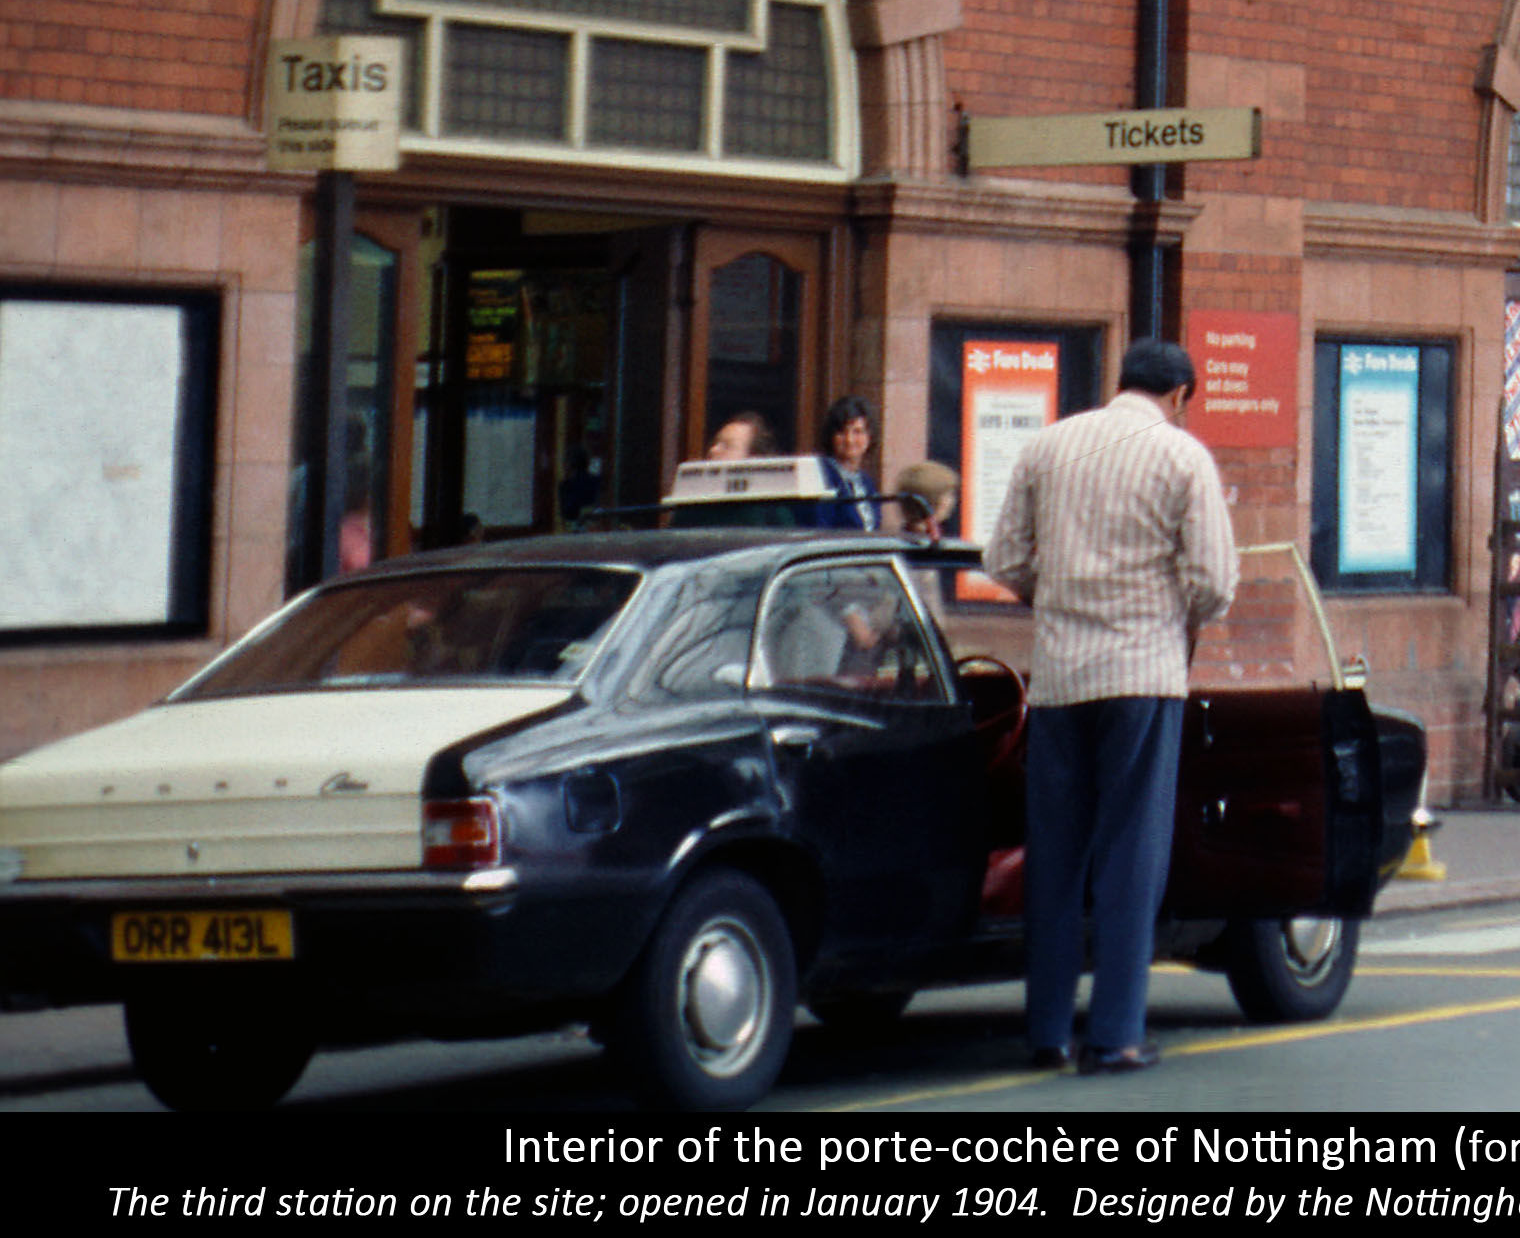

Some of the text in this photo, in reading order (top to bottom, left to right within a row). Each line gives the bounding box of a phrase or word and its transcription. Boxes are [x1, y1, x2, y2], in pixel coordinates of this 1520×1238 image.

[282, 53, 388, 93] Taxis
[1103, 117, 1205, 149] Tickets
[1205, 330, 1257, 351] No parking
[1205, 359, 1249, 379] Cars may
[1204, 397, 1280, 416] passengers only
[123, 916, 279, 955] ORR 413L
